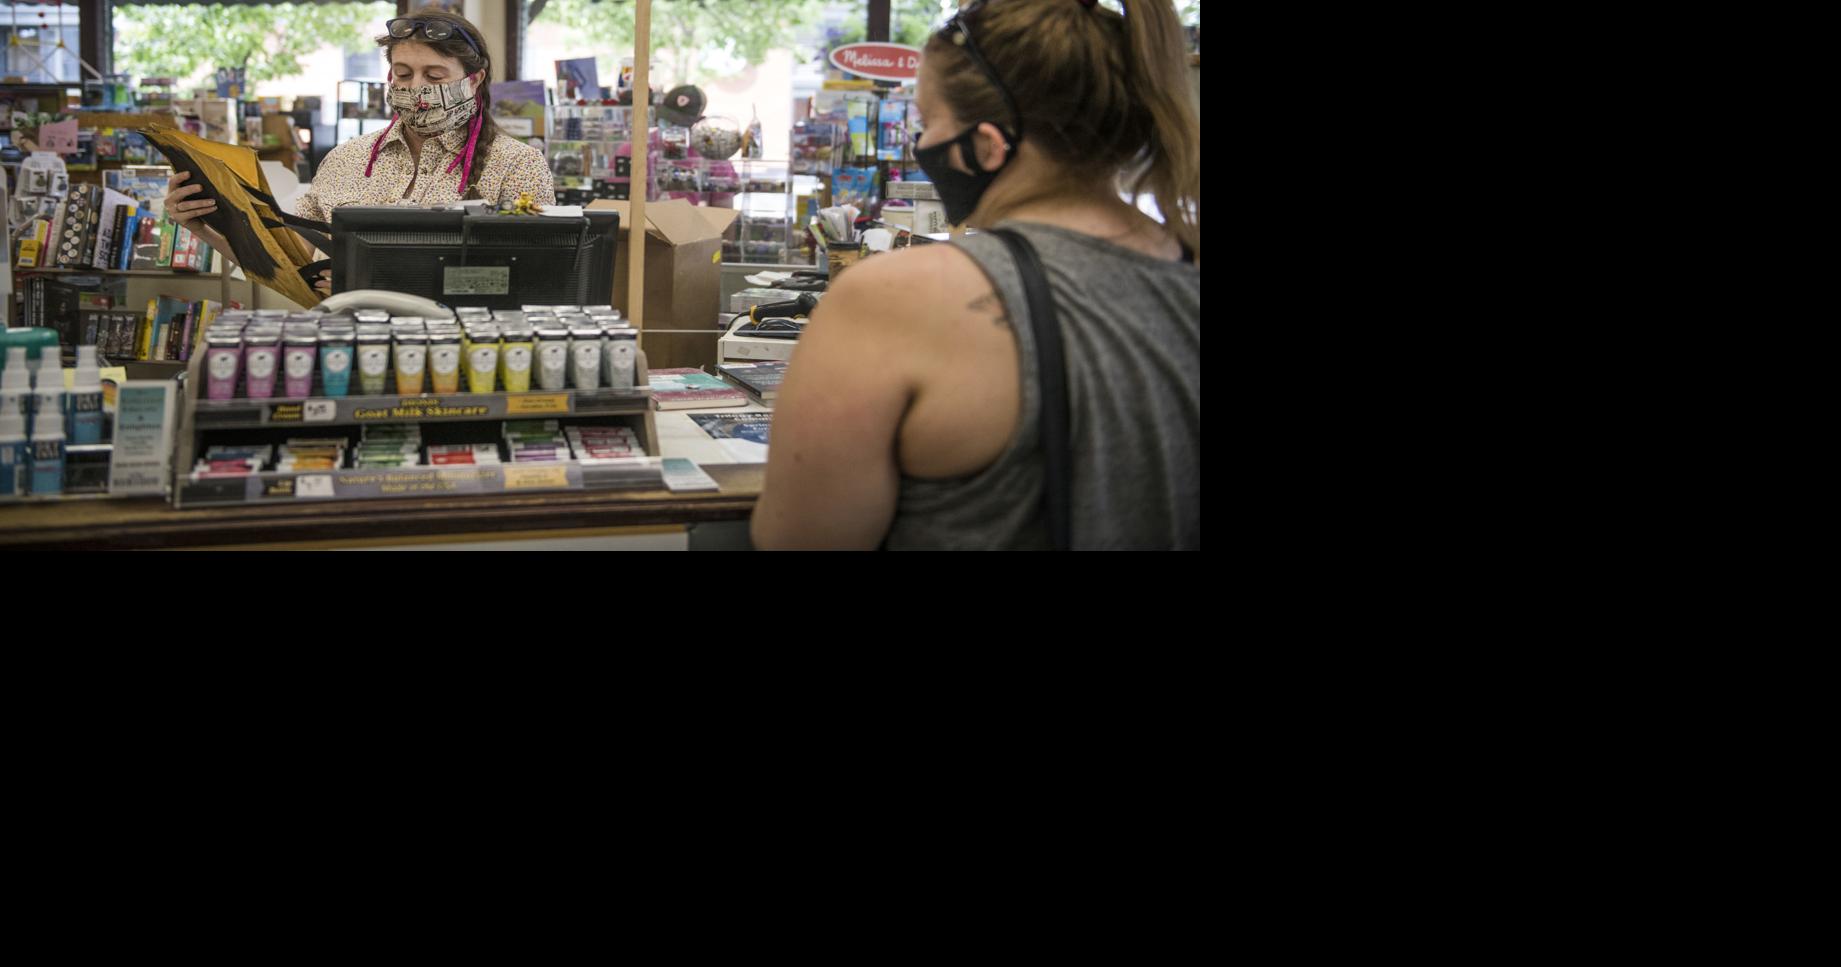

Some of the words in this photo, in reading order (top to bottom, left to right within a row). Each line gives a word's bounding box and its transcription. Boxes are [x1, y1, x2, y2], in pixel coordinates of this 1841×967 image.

[843, 50, 893, 67] Melissa
[354, 408, 388, 419] Goat
[391, 405, 422, 417] Milk
[426, 405, 487, 416] Skincare
